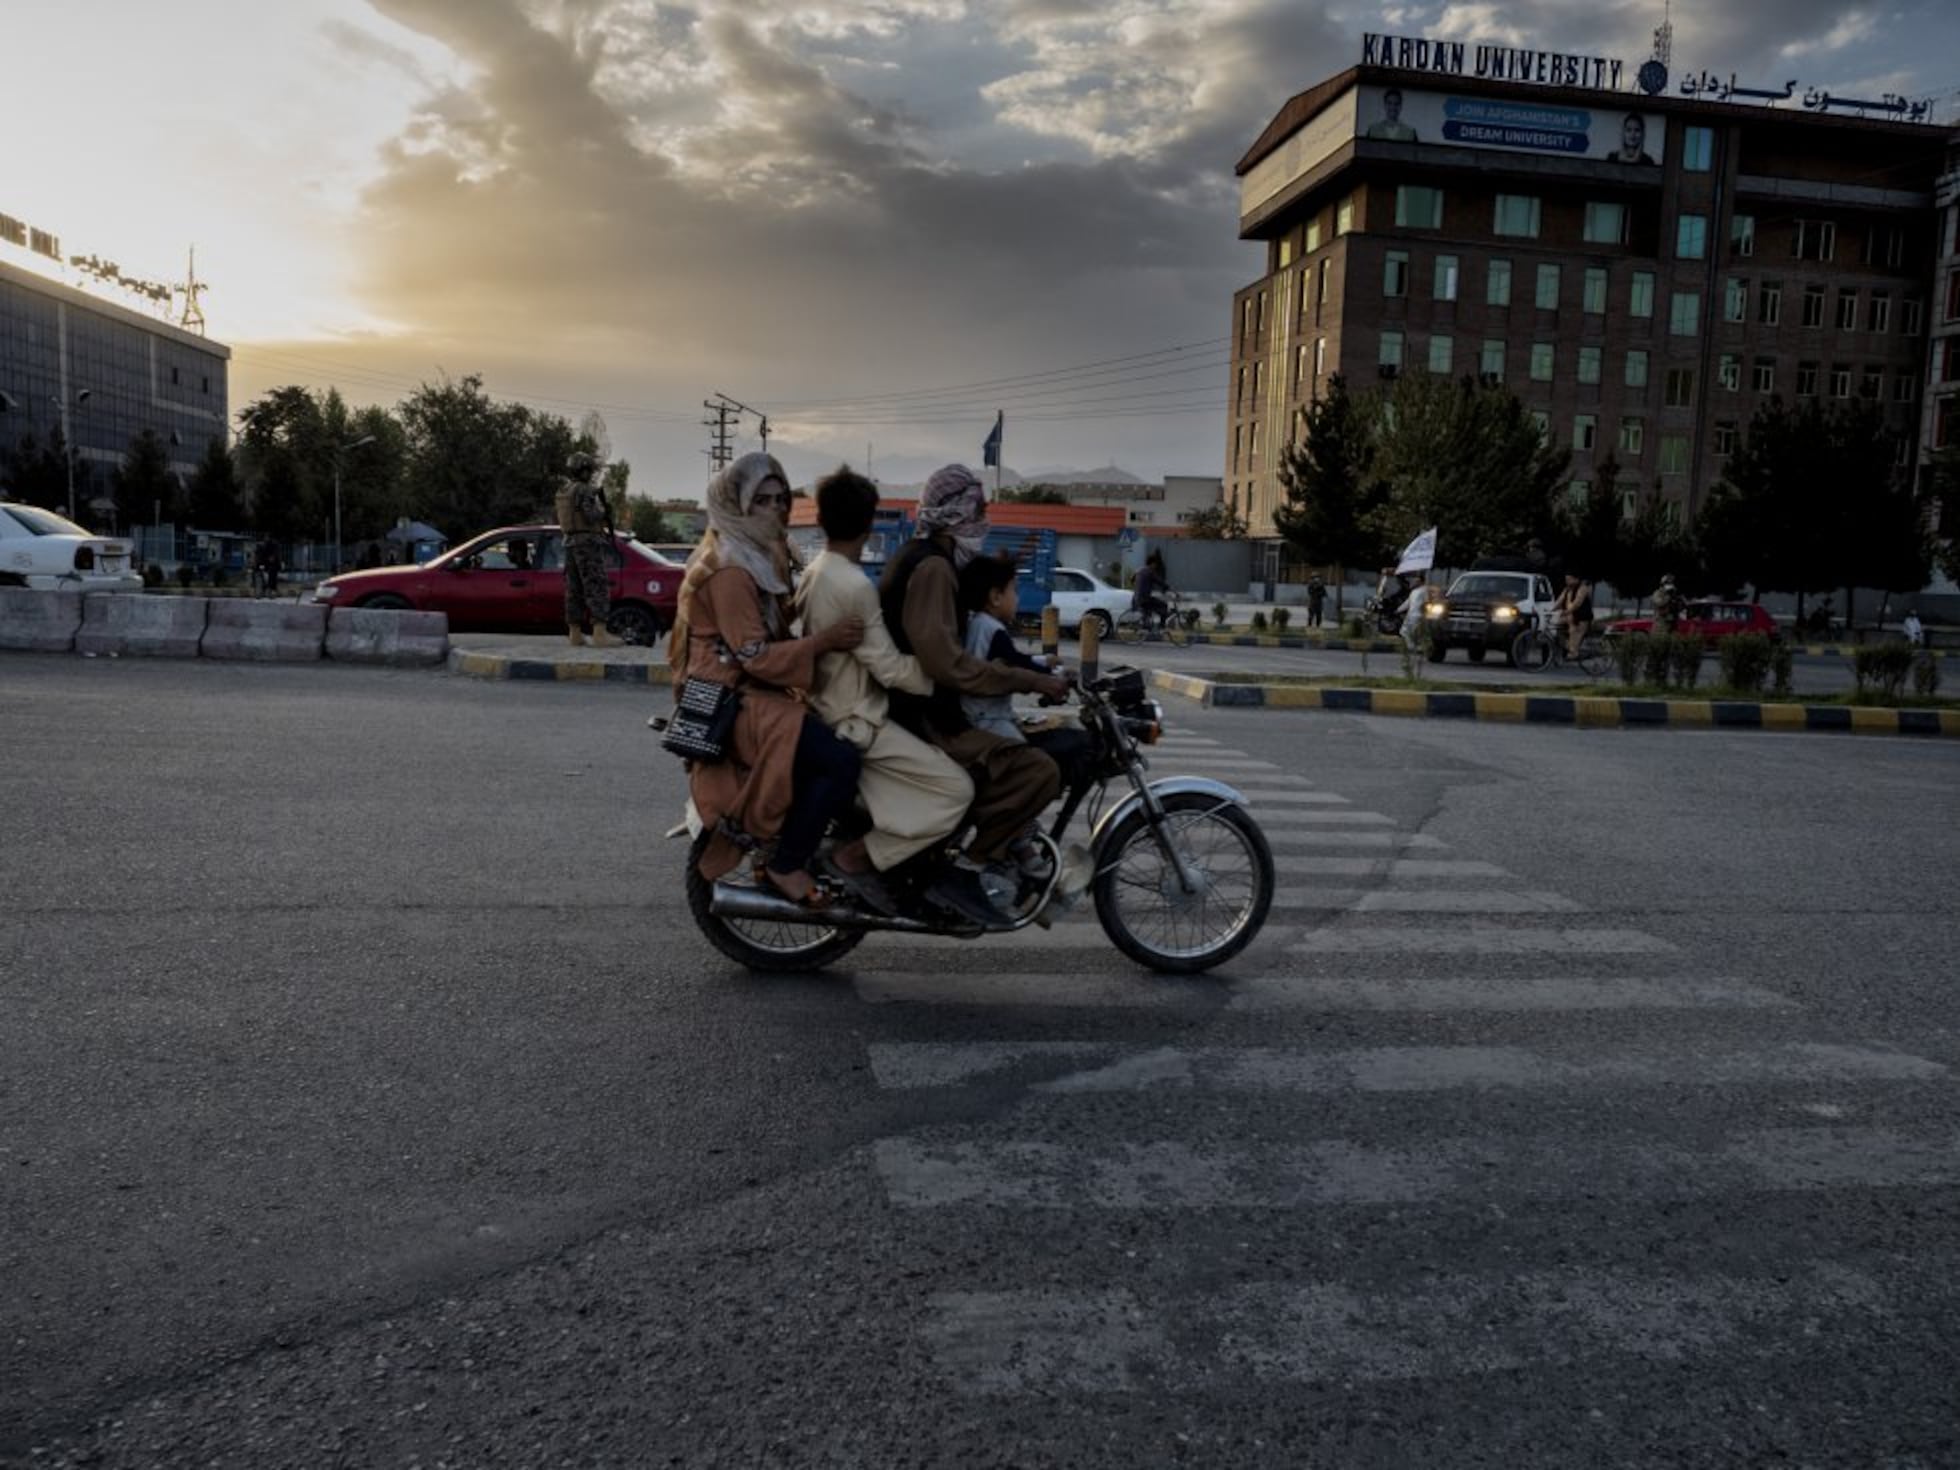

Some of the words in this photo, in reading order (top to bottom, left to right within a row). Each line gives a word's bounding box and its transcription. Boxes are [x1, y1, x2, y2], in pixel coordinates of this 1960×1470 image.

[1362, 32, 1465, 74] KARDAN
[1475, 45, 1623, 89] UNIVERSITY
[1455, 103, 1486, 117] JOIN
[1459, 125, 1504, 140] DREAM
[1504, 130, 1572, 148] UNIVERSITY
